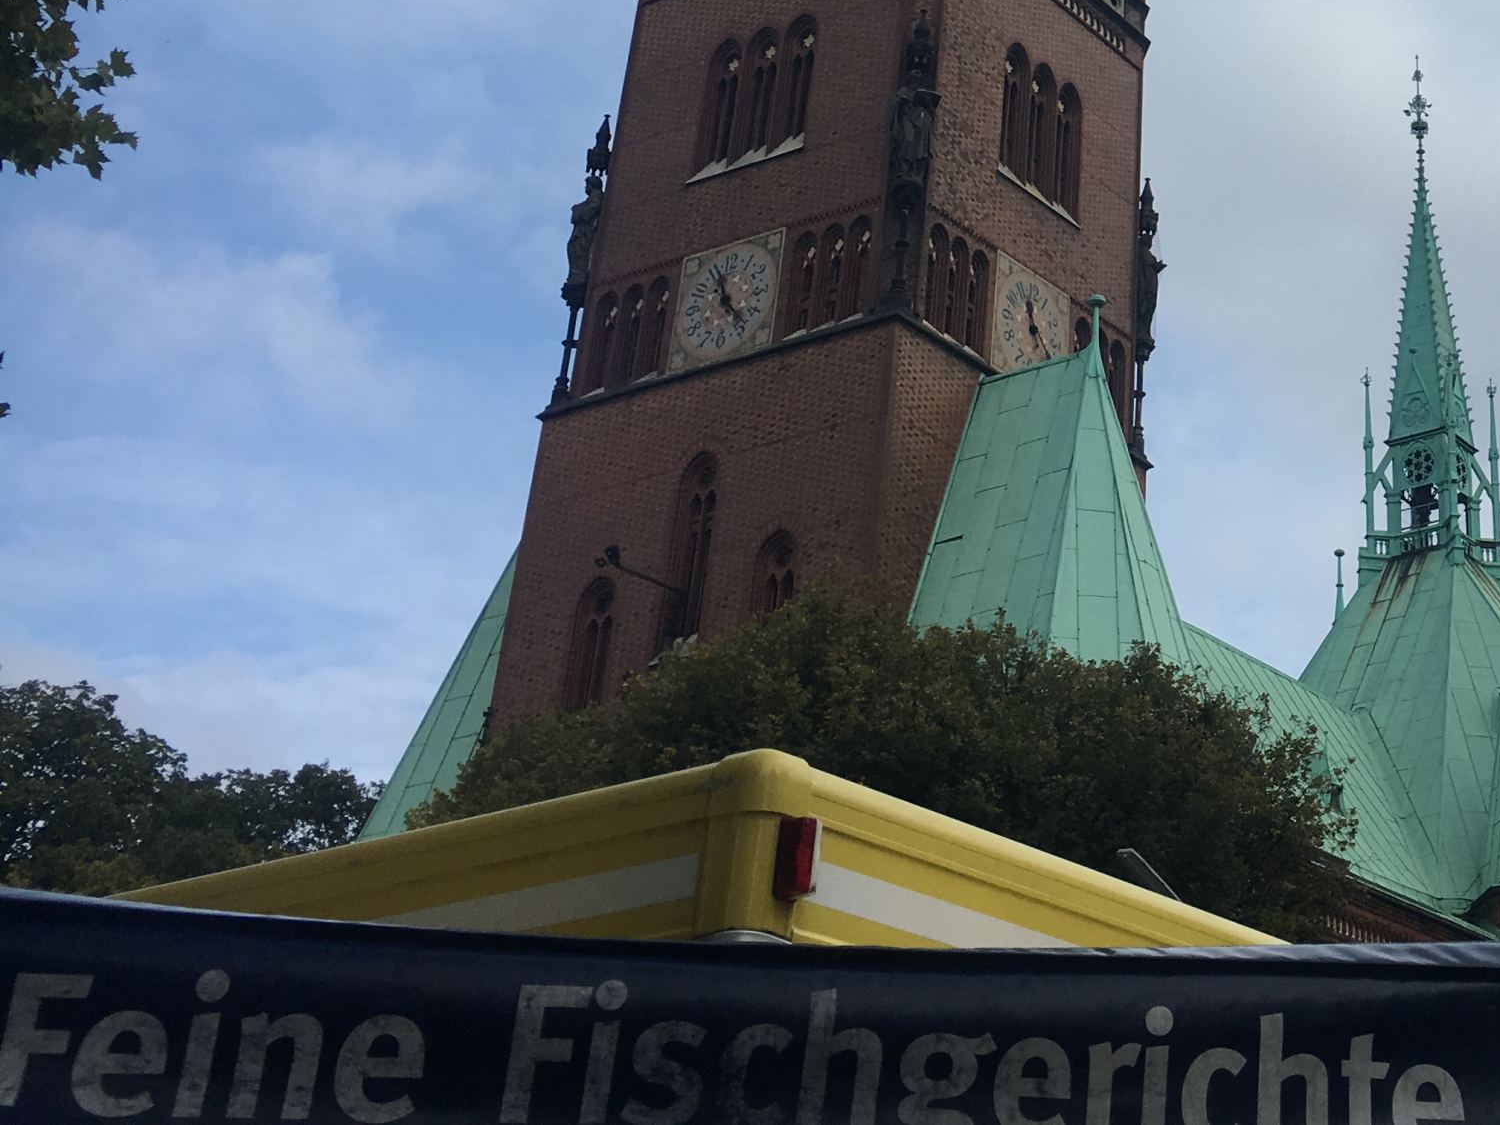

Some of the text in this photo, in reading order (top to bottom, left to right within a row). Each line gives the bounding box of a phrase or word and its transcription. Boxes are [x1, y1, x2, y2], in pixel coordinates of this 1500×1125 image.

[725, 253, 738, 272] 12
[743, 254, 754, 271] 1
[751, 264, 766, 280] 2
[691, 283, 708, 299] 10
[752, 284, 768, 296] 3
[1028, 283, 1039, 302] 12
[686, 305, 700, 317] 9
[747, 306, 760, 317] 4
[1002, 308, 1014, 320] 9
[687, 321, 701, 337] 8
[733, 319, 749, 339] 5
[1048, 318, 1058, 329] 2
[699, 330, 712, 348] 7
[715, 331, 726, 348] 6
[1004, 329, 1015, 341] 8
[1050, 338, 1061, 351] 3
[1014, 348, 1024, 363] 7
[0, 969, 1465, 1125] Feine Fischgerichte
